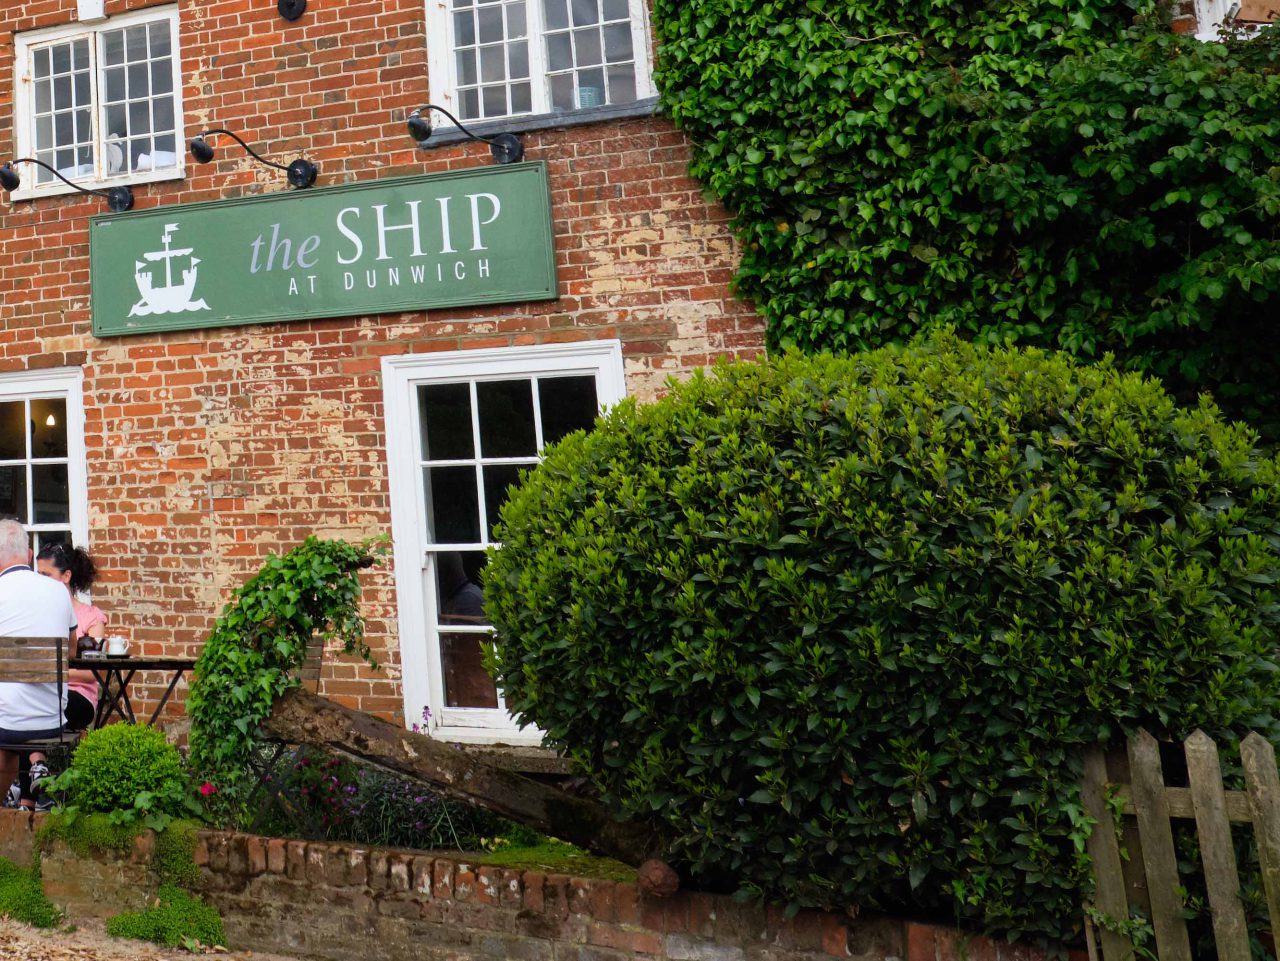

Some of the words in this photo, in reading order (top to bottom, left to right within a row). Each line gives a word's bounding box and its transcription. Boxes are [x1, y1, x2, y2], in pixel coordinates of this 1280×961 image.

[250, 223, 321, 274] the
[336, 192, 502, 266] SHIP
[288, 275, 317, 296] AT
[344, 258, 491, 291] DUNWICH
